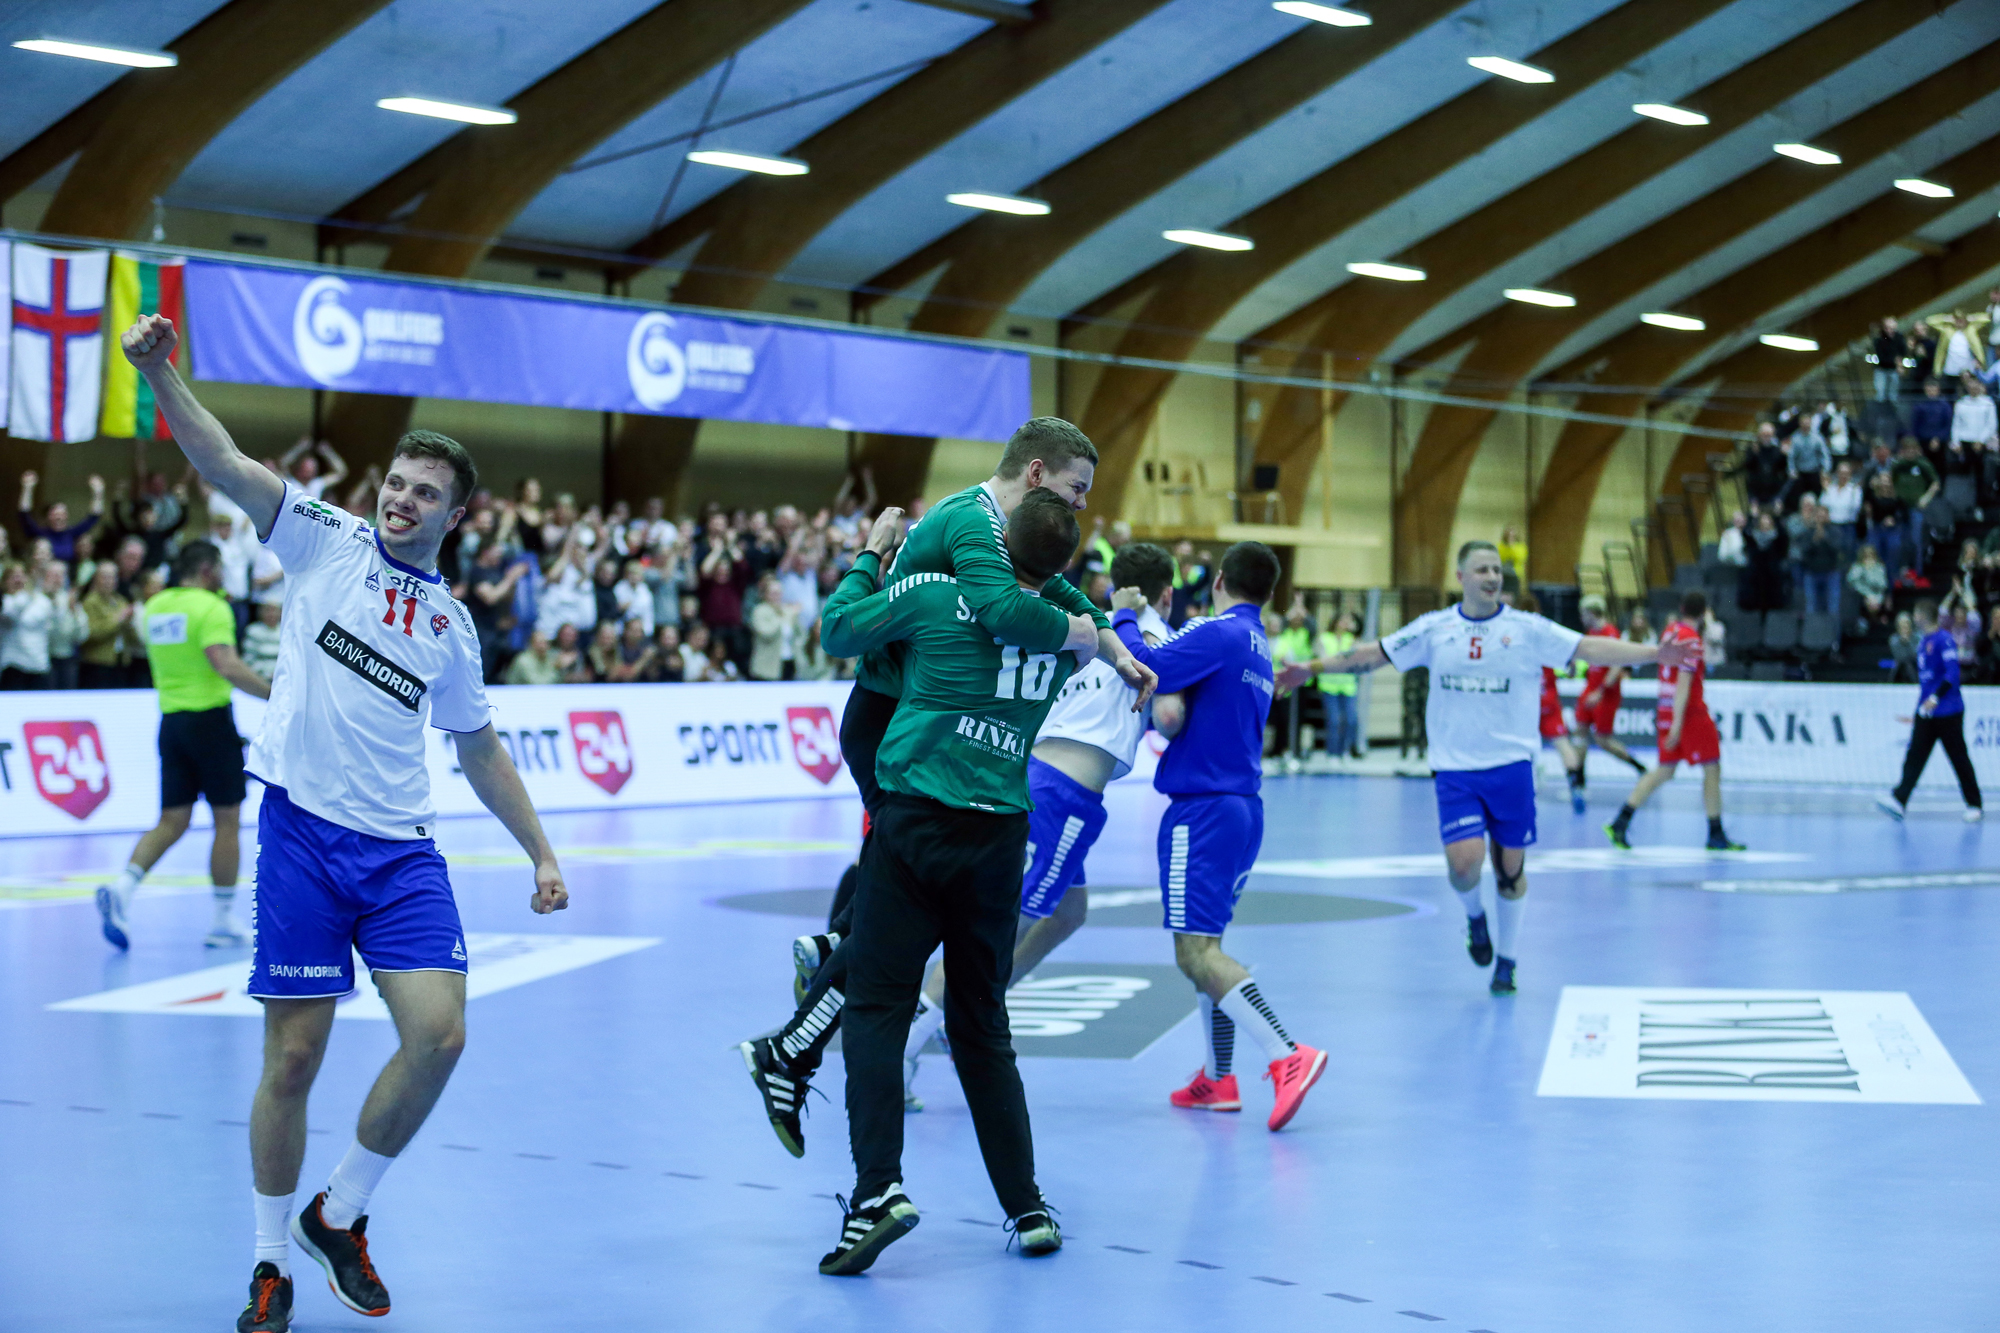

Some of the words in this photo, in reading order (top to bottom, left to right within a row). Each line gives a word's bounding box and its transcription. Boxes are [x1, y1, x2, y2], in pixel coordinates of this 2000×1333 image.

[382, 588, 418, 638] 11
[1469, 637, 1483, 660] 5
[33, 734, 106, 794] 24
[574, 721, 630, 775] 24
[678, 723, 781, 765] SPORT
[790, 717, 841, 768] 24
[968, 740, 991, 753] FINEST
